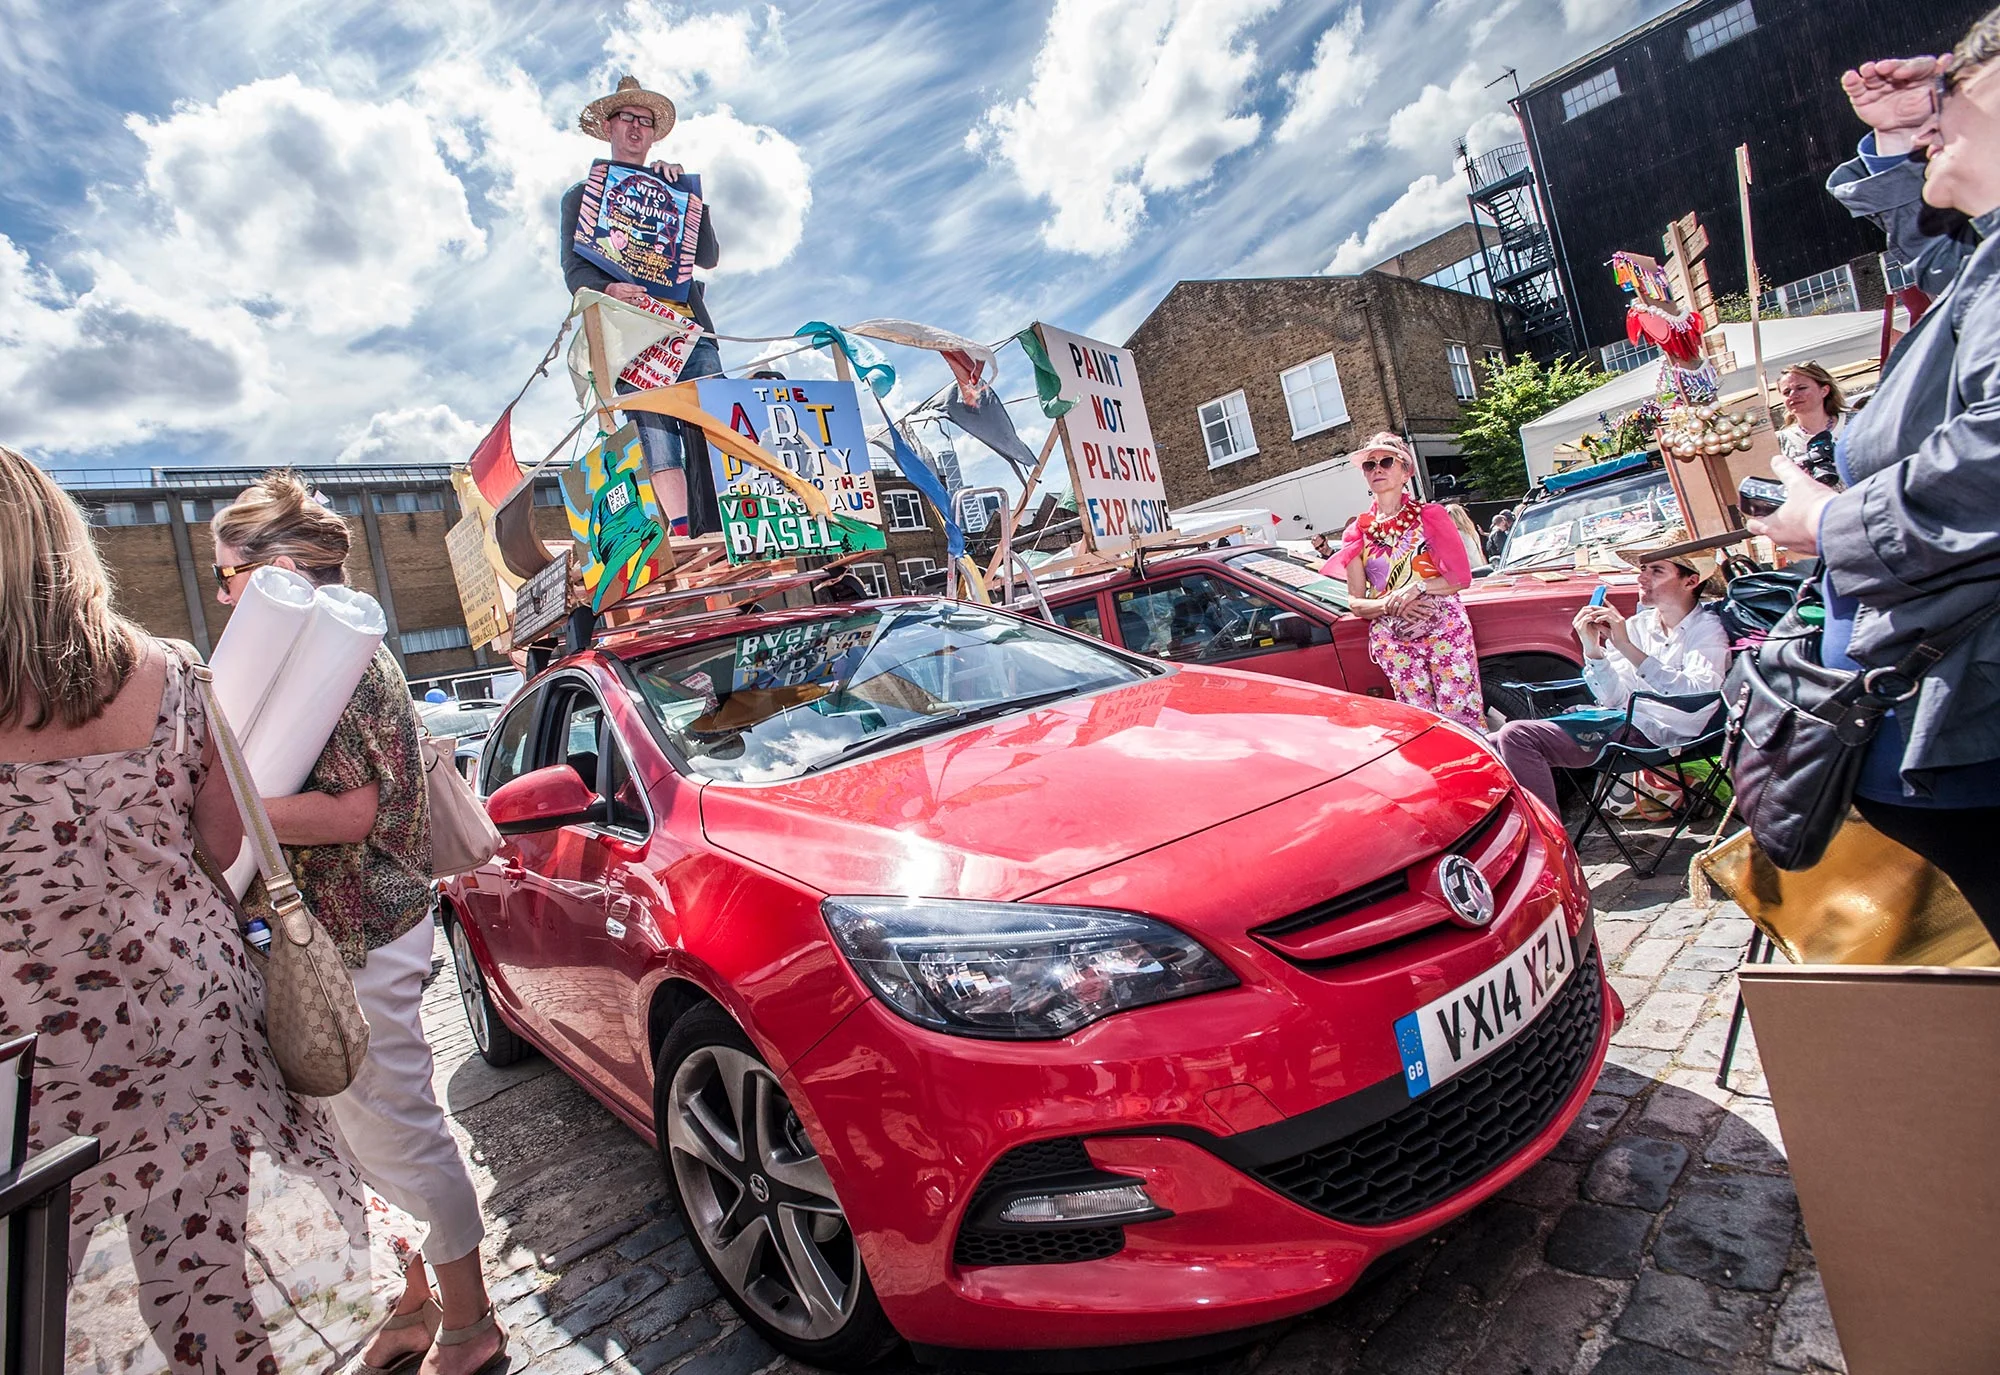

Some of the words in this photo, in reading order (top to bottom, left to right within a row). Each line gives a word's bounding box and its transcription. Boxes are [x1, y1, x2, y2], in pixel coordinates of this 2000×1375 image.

[636, 182, 666, 202] WHO
[645, 197, 660, 208] IS
[606, 191, 678, 225] COMMUNITY
[1068, 342, 1123, 388] PAINT
[753, 387, 809, 403] THE
[729, 402, 835, 447] ART
[1091, 394, 1126, 433] NOT
[1082, 442, 1156, 483] PLASTIC
[609, 485, 624, 499] NOT
[830, 475, 870, 490] THE
[611, 493, 626, 506] FOR
[721, 491, 875, 520] VOLKSAUS
[1087, 498, 1172, 536] EXPLOSIVE
[729, 516, 841, 555] BASEL
[1436, 967, 1521, 1062] VX14
[1523, 919, 1567, 1007] XZJ
[1408, 1060, 1425, 1081] GB
